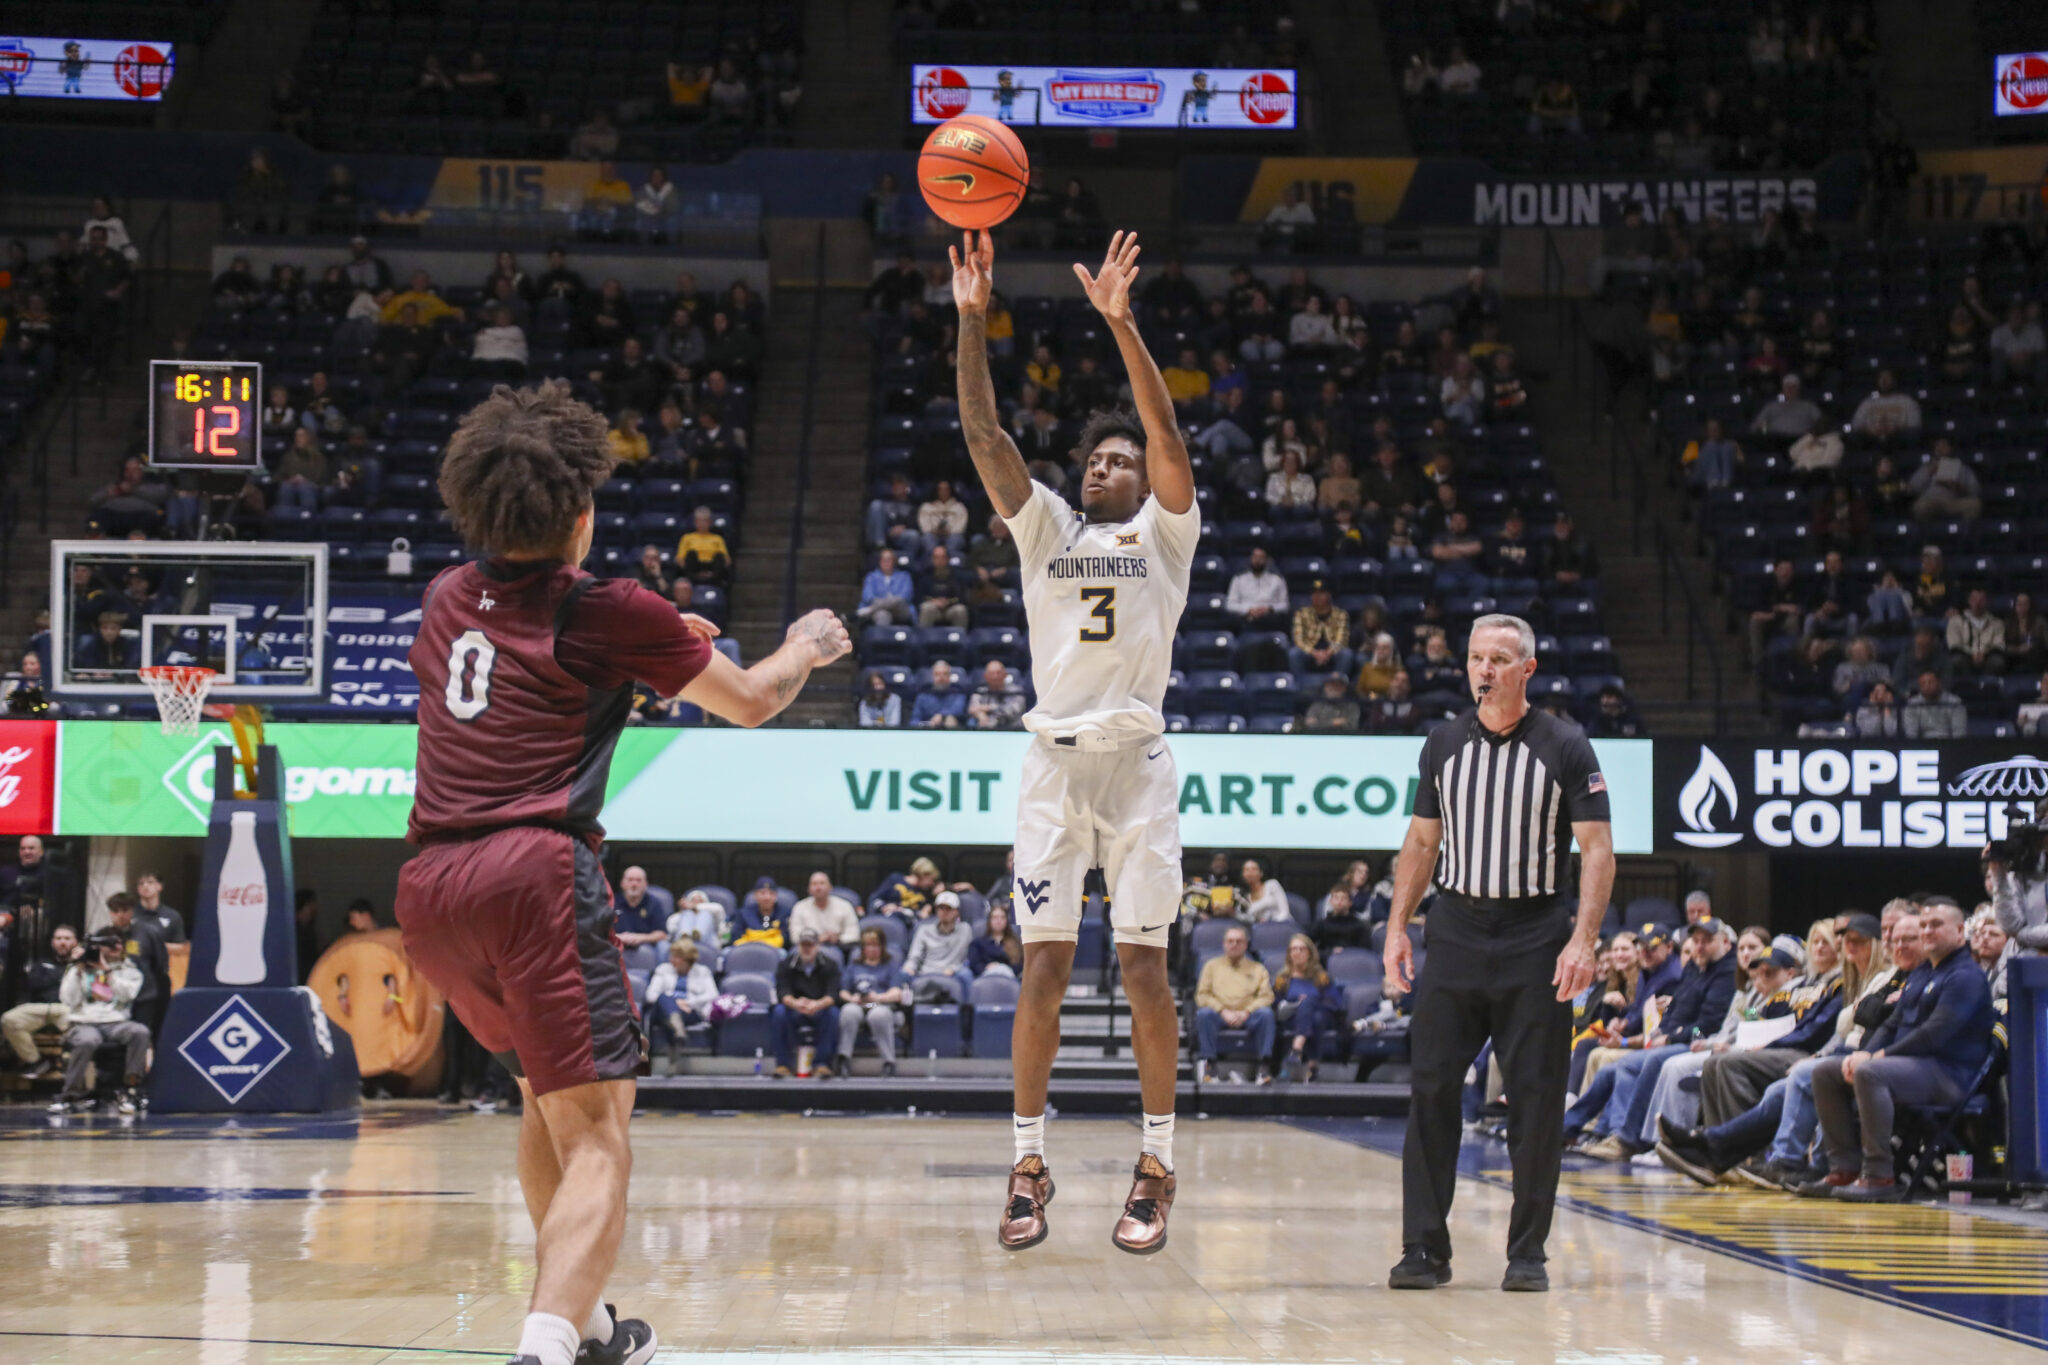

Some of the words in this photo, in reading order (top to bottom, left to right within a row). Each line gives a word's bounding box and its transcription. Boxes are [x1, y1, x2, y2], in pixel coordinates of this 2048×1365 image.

[478, 165, 545, 209] 115
[1474, 178, 1818, 226] MOUNTAINEERS
[175, 373, 250, 402] 16:11
[194, 405, 240, 456] 12
[1047, 556, 1148, 578] MOUNTAINEERS
[1079, 586, 1116, 643] 3
[445, 629, 498, 723] 0
[845, 769, 1001, 811] VISIT
[1754, 749, 1940, 796] HOPE
